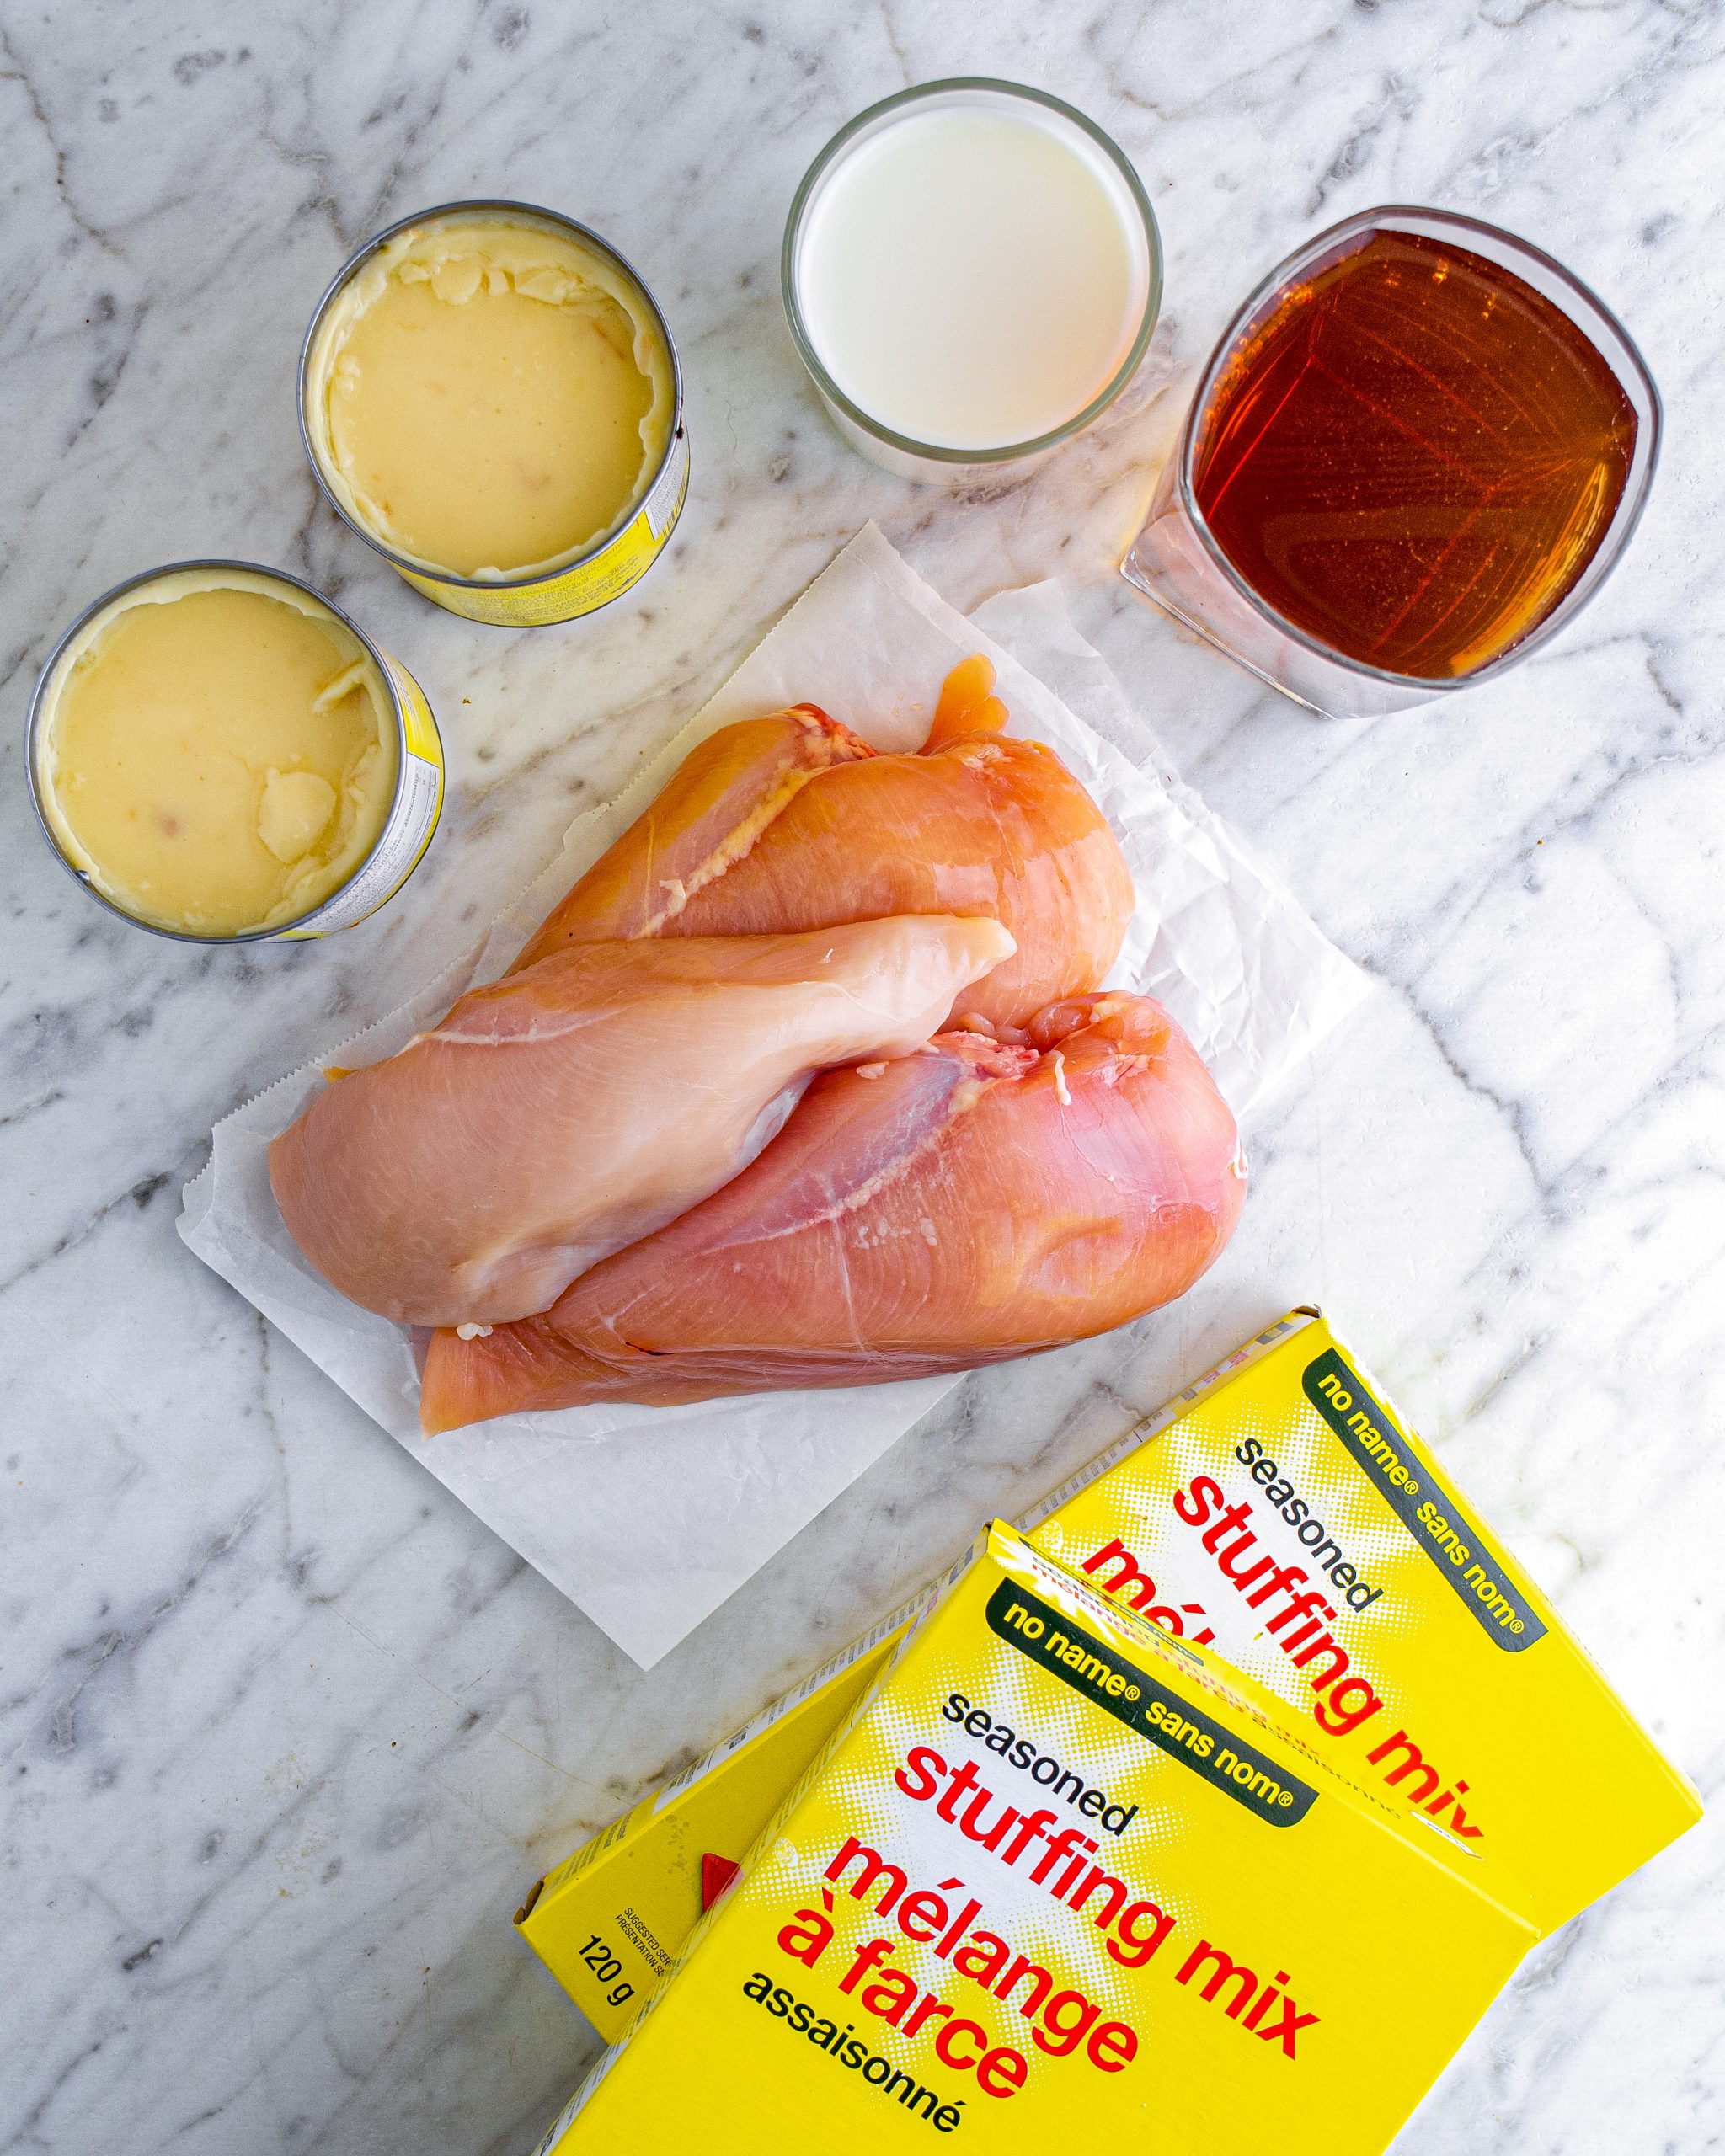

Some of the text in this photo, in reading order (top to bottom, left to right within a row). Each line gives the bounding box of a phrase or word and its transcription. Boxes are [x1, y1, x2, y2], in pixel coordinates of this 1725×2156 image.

[1235, 1438, 1384, 1613] seasoned
[1317, 1372, 1353, 1412] no
[1416, 1501, 1470, 1566] sans
[1002, 1602, 1044, 1640] no
[1145, 1700, 1215, 1758] sans
[1172, 1476, 1384, 1737] stuffing
[942, 1694, 1140, 1837] seasoned
[579, 1934, 622, 1983] 120
[606, 1983, 635, 2007] g
[614, 1913, 658, 1967] PRÉSENTATION
[624, 1907, 660, 1951] SUGGESTED
[823, 1835, 1138, 2073] mélange
[895, 1746, 1321, 2061] stuffing mix
[743, 1972, 968, 2133] assaisonné
[777, 1886, 835, 1969] à
[837, 1939, 1028, 2099] farce
